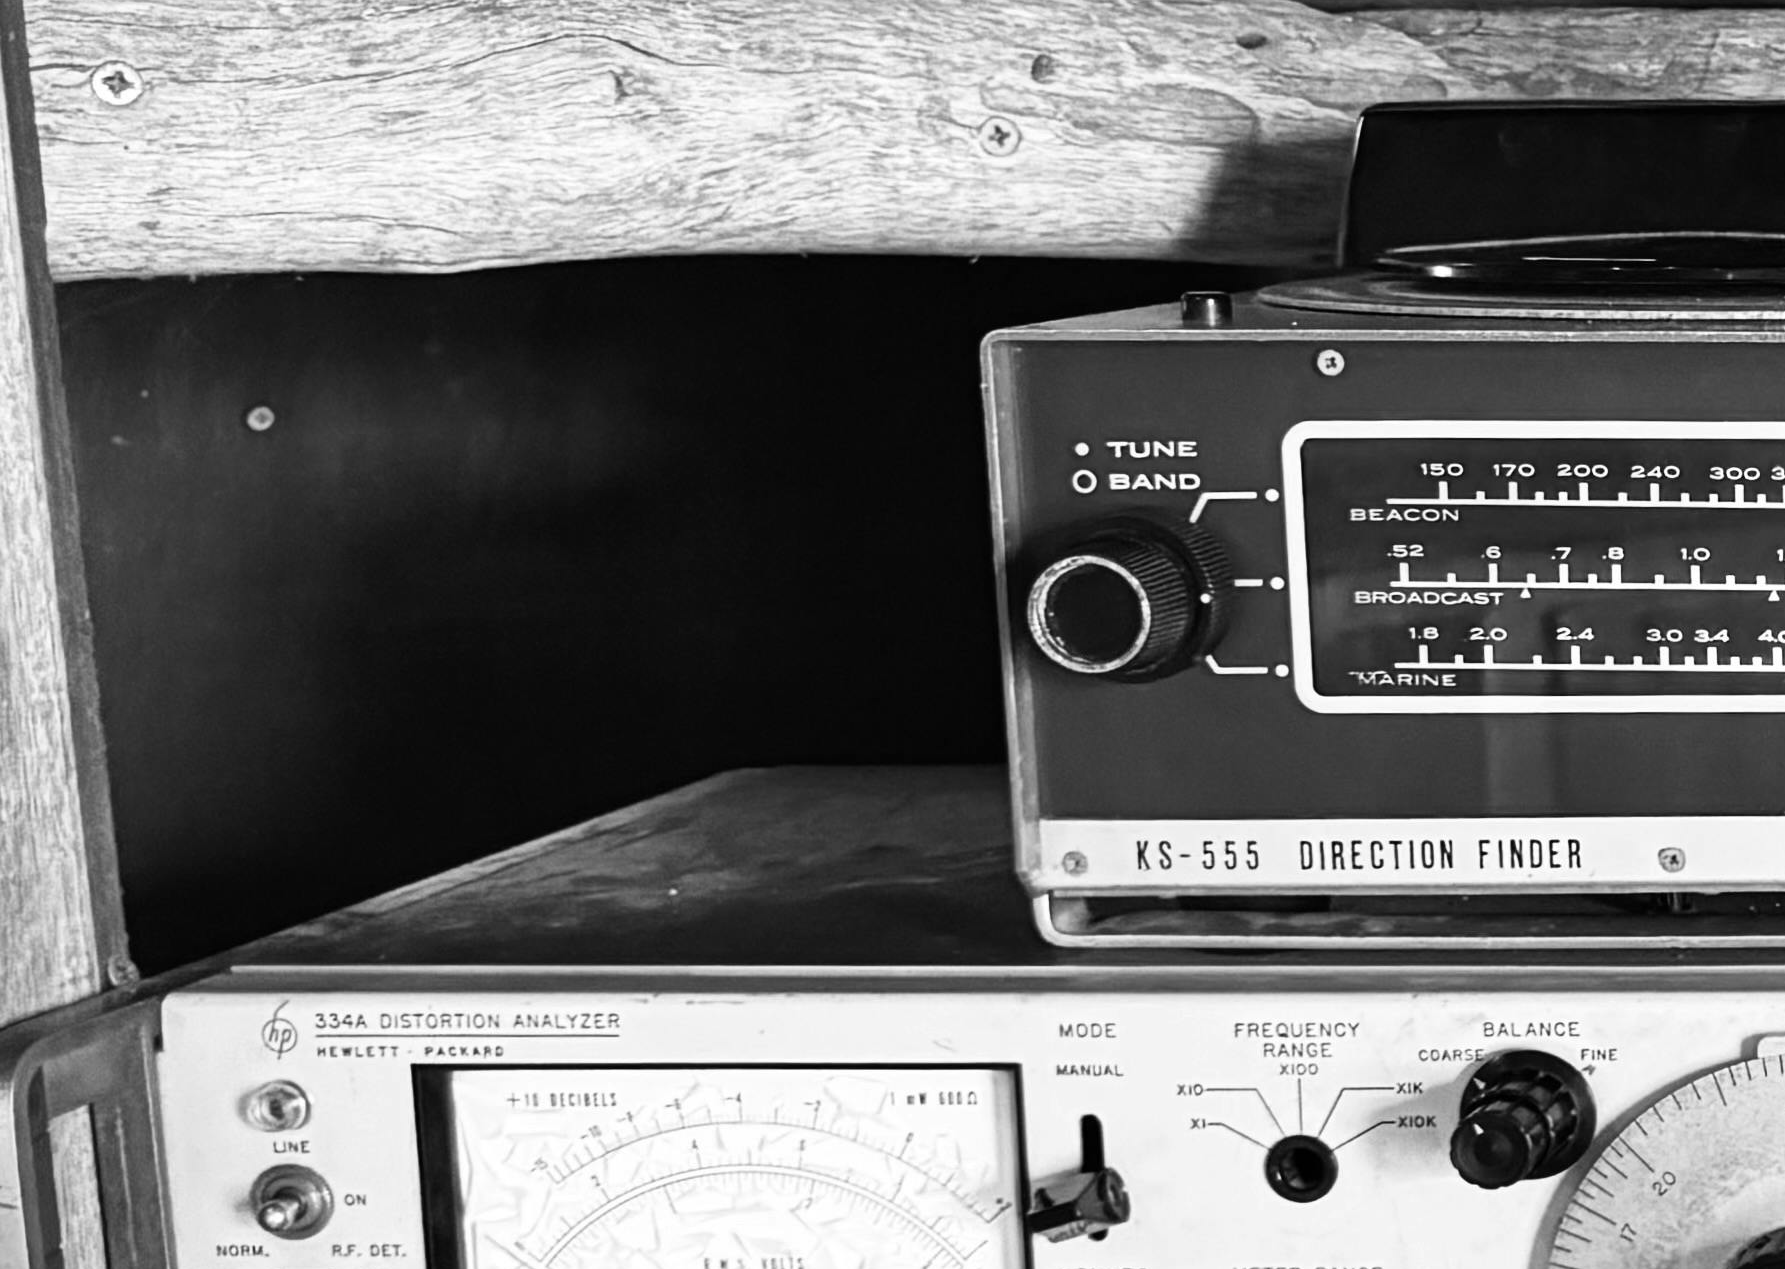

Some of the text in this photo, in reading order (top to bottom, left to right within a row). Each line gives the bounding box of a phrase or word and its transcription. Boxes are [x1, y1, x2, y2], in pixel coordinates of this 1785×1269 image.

[1107, 441, 1197, 458] TUNE
[1421, 464, 1463, 476] 150
[1494, 464, 1535, 476] 170
[1558, 464, 1608, 477] 200
[1630, 464, 1680, 479] 240
[1710, 467, 1760, 480] 300
[1109, 474, 1200, 490] BAND
[1351, 509, 1458, 521] BEACON
[1355, 591, 1504, 605] BROADCAST
[1353, 671, 1456, 686] MARINE
[1137, 839, 1581, 870] KS-555 DIRECTION FINDER
[316, 1013, 620, 1029] 334A DISTORTION ANALYZER
[1059, 1023, 1116, 1038] MODE
[1235, 1023, 1359, 1038] FREQUENCY
[1483, 1022, 1580, 1037] BALANCE
[317, 1046, 503, 1057] HEWLETT PACKARD
[1264, 1043, 1332, 1057] RANGE
[1057, 1065, 1123, 1077] MANUAL
